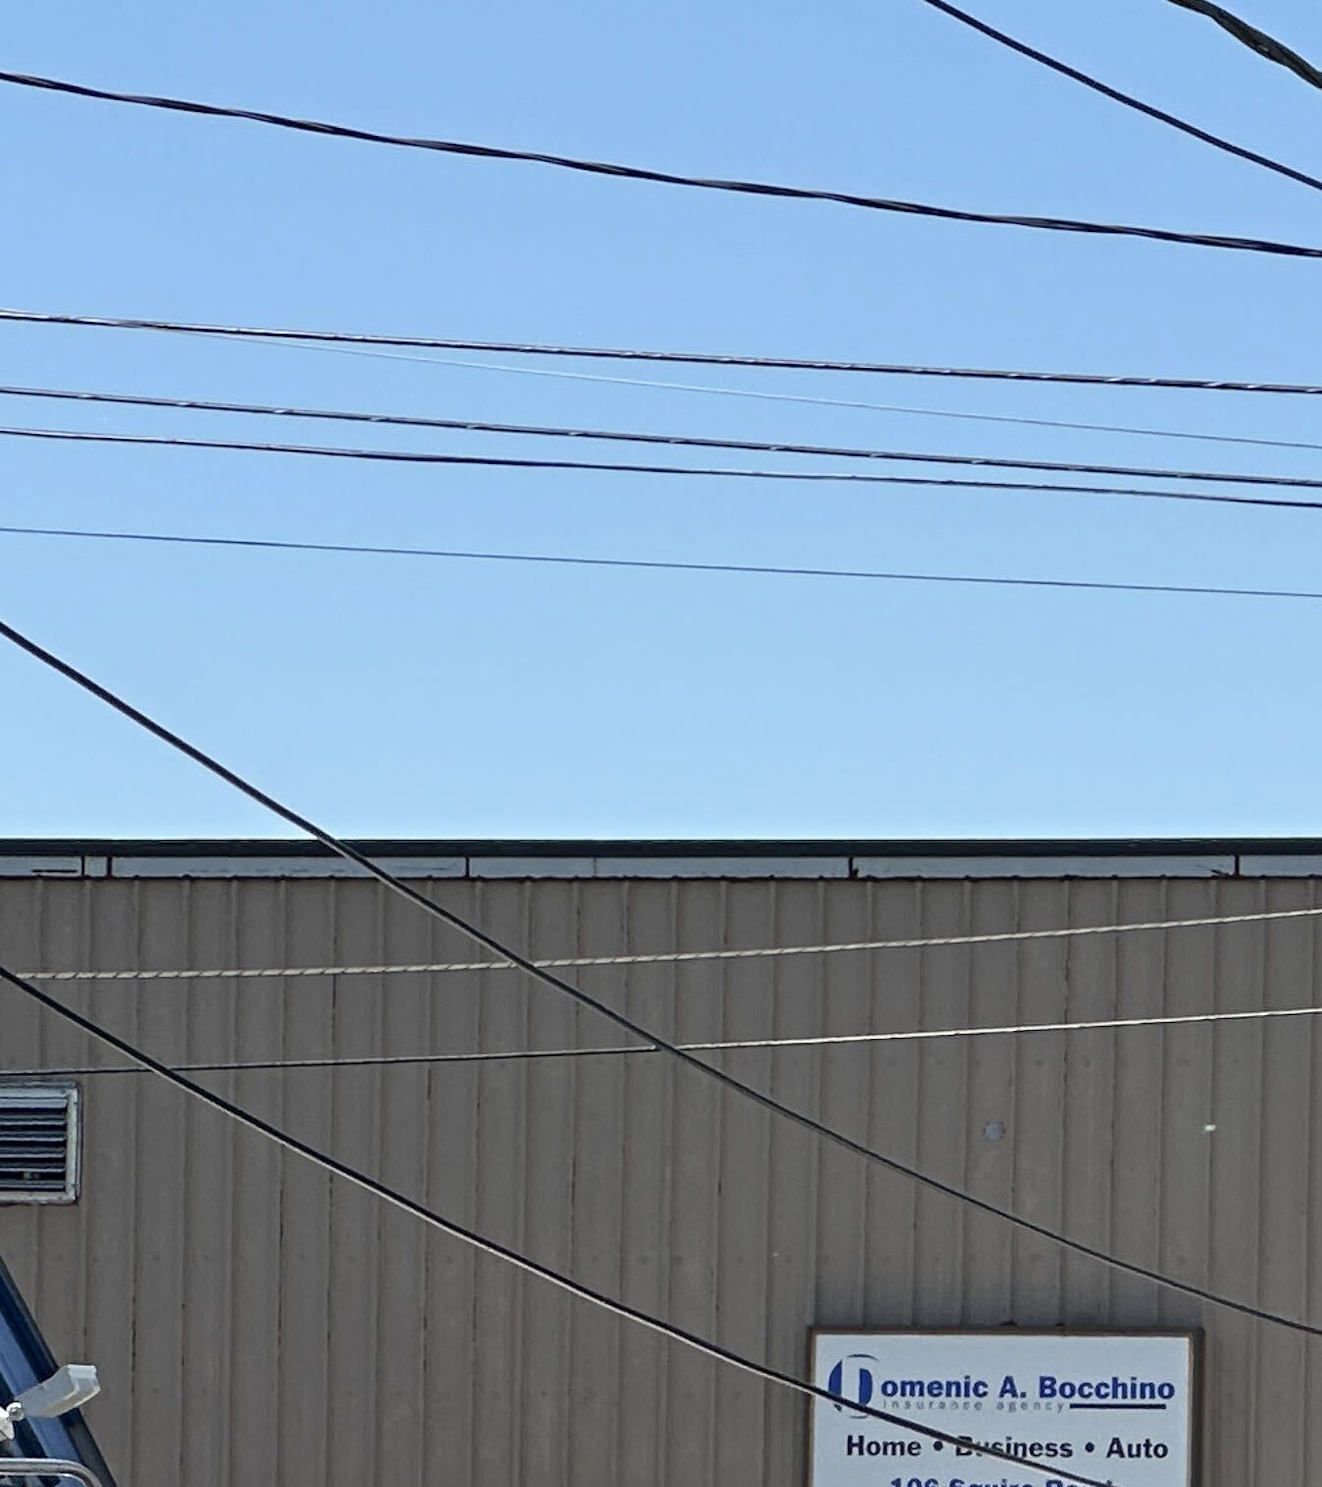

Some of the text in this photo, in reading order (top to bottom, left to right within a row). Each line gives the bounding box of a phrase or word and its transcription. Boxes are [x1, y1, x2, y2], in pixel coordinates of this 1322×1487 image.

[999, 1375, 1027, 1399] A.
[1039, 1376, 1175, 1400] Bocchino
[997, 1399, 1065, 1413] agency
[847, 1435, 921, 1456] Home
[1106, 1437, 1168, 1459] Auto
